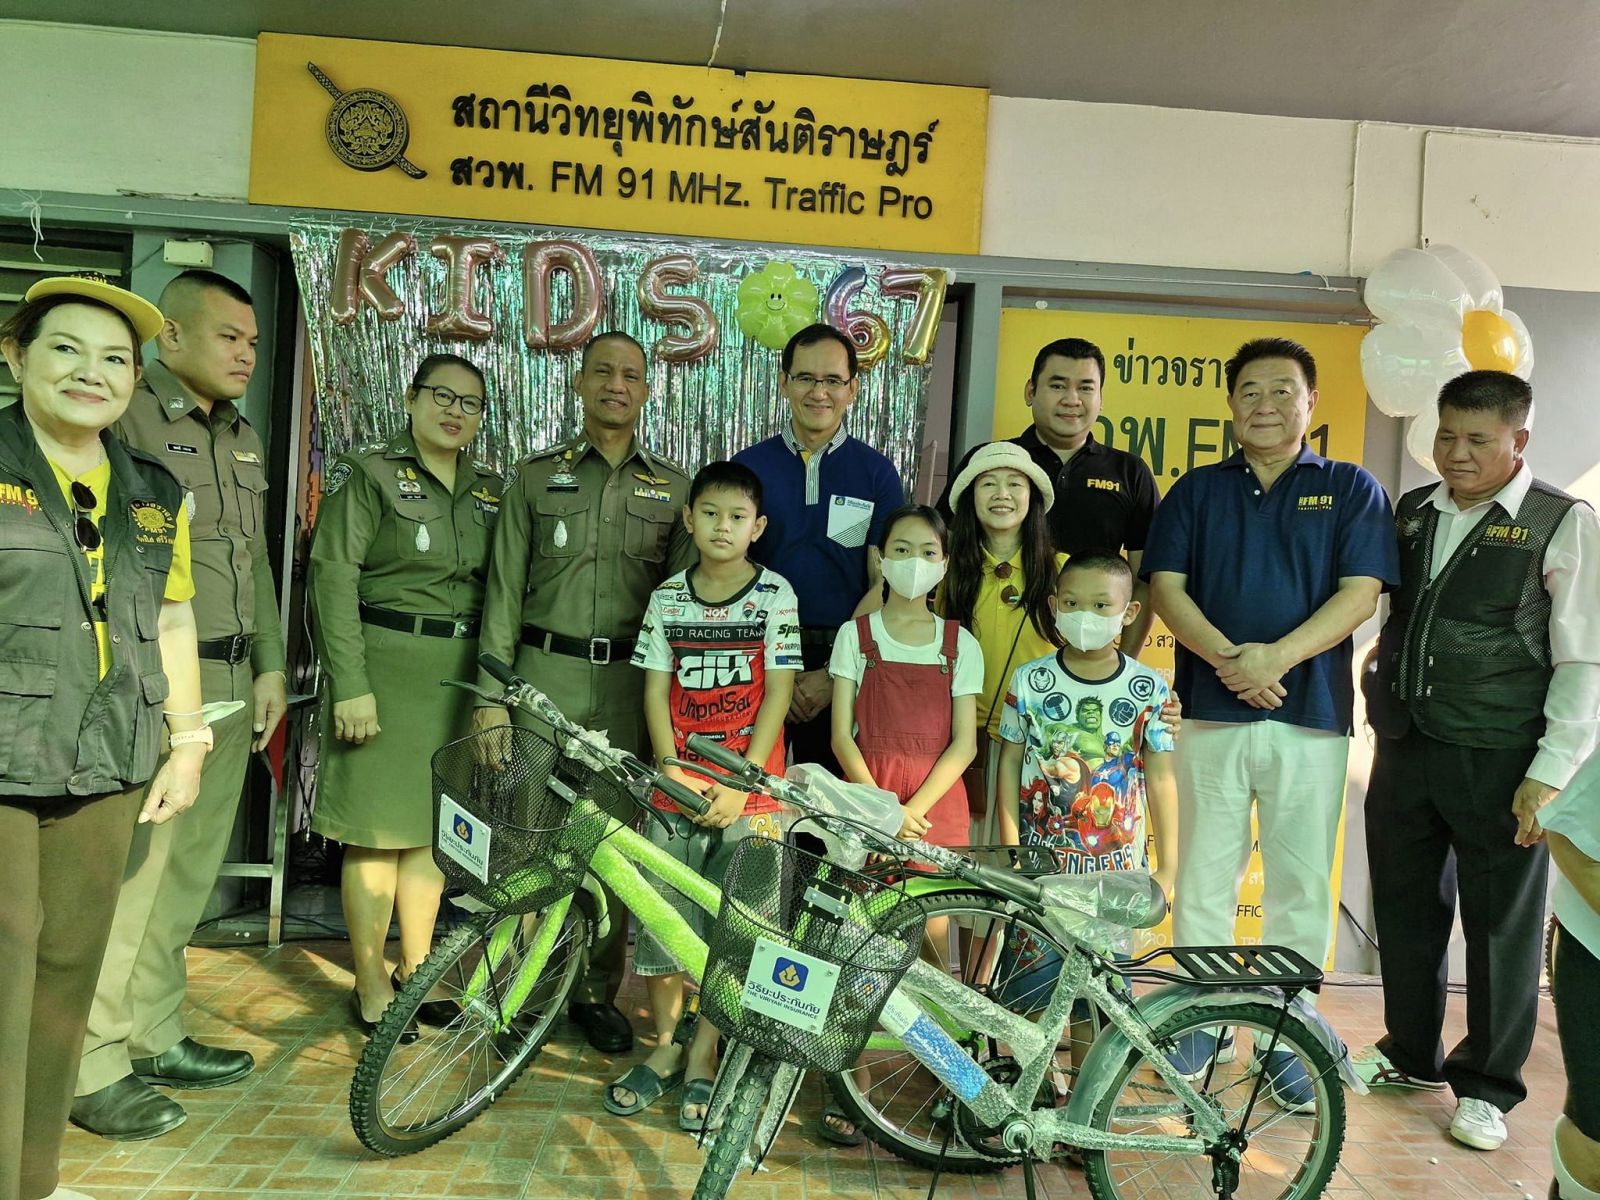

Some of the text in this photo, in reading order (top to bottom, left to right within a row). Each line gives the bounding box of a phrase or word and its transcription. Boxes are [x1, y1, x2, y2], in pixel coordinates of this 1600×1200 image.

[452, 82, 940, 177] สถานีวิทยุพิทักษ์สันติราษฎร์
[450, 156, 933, 219] สวพ. FM 91 MHz. Traffic Pro
[823, 263, 949, 371] 67
[1113, 337, 1233, 389] ข่าวจรา
[1087, 478, 1120, 492] FM91
[1511, 526, 1529, 541] 91
[704, 607, 729, 618] NGK
[688, 628, 731, 639] RACING
